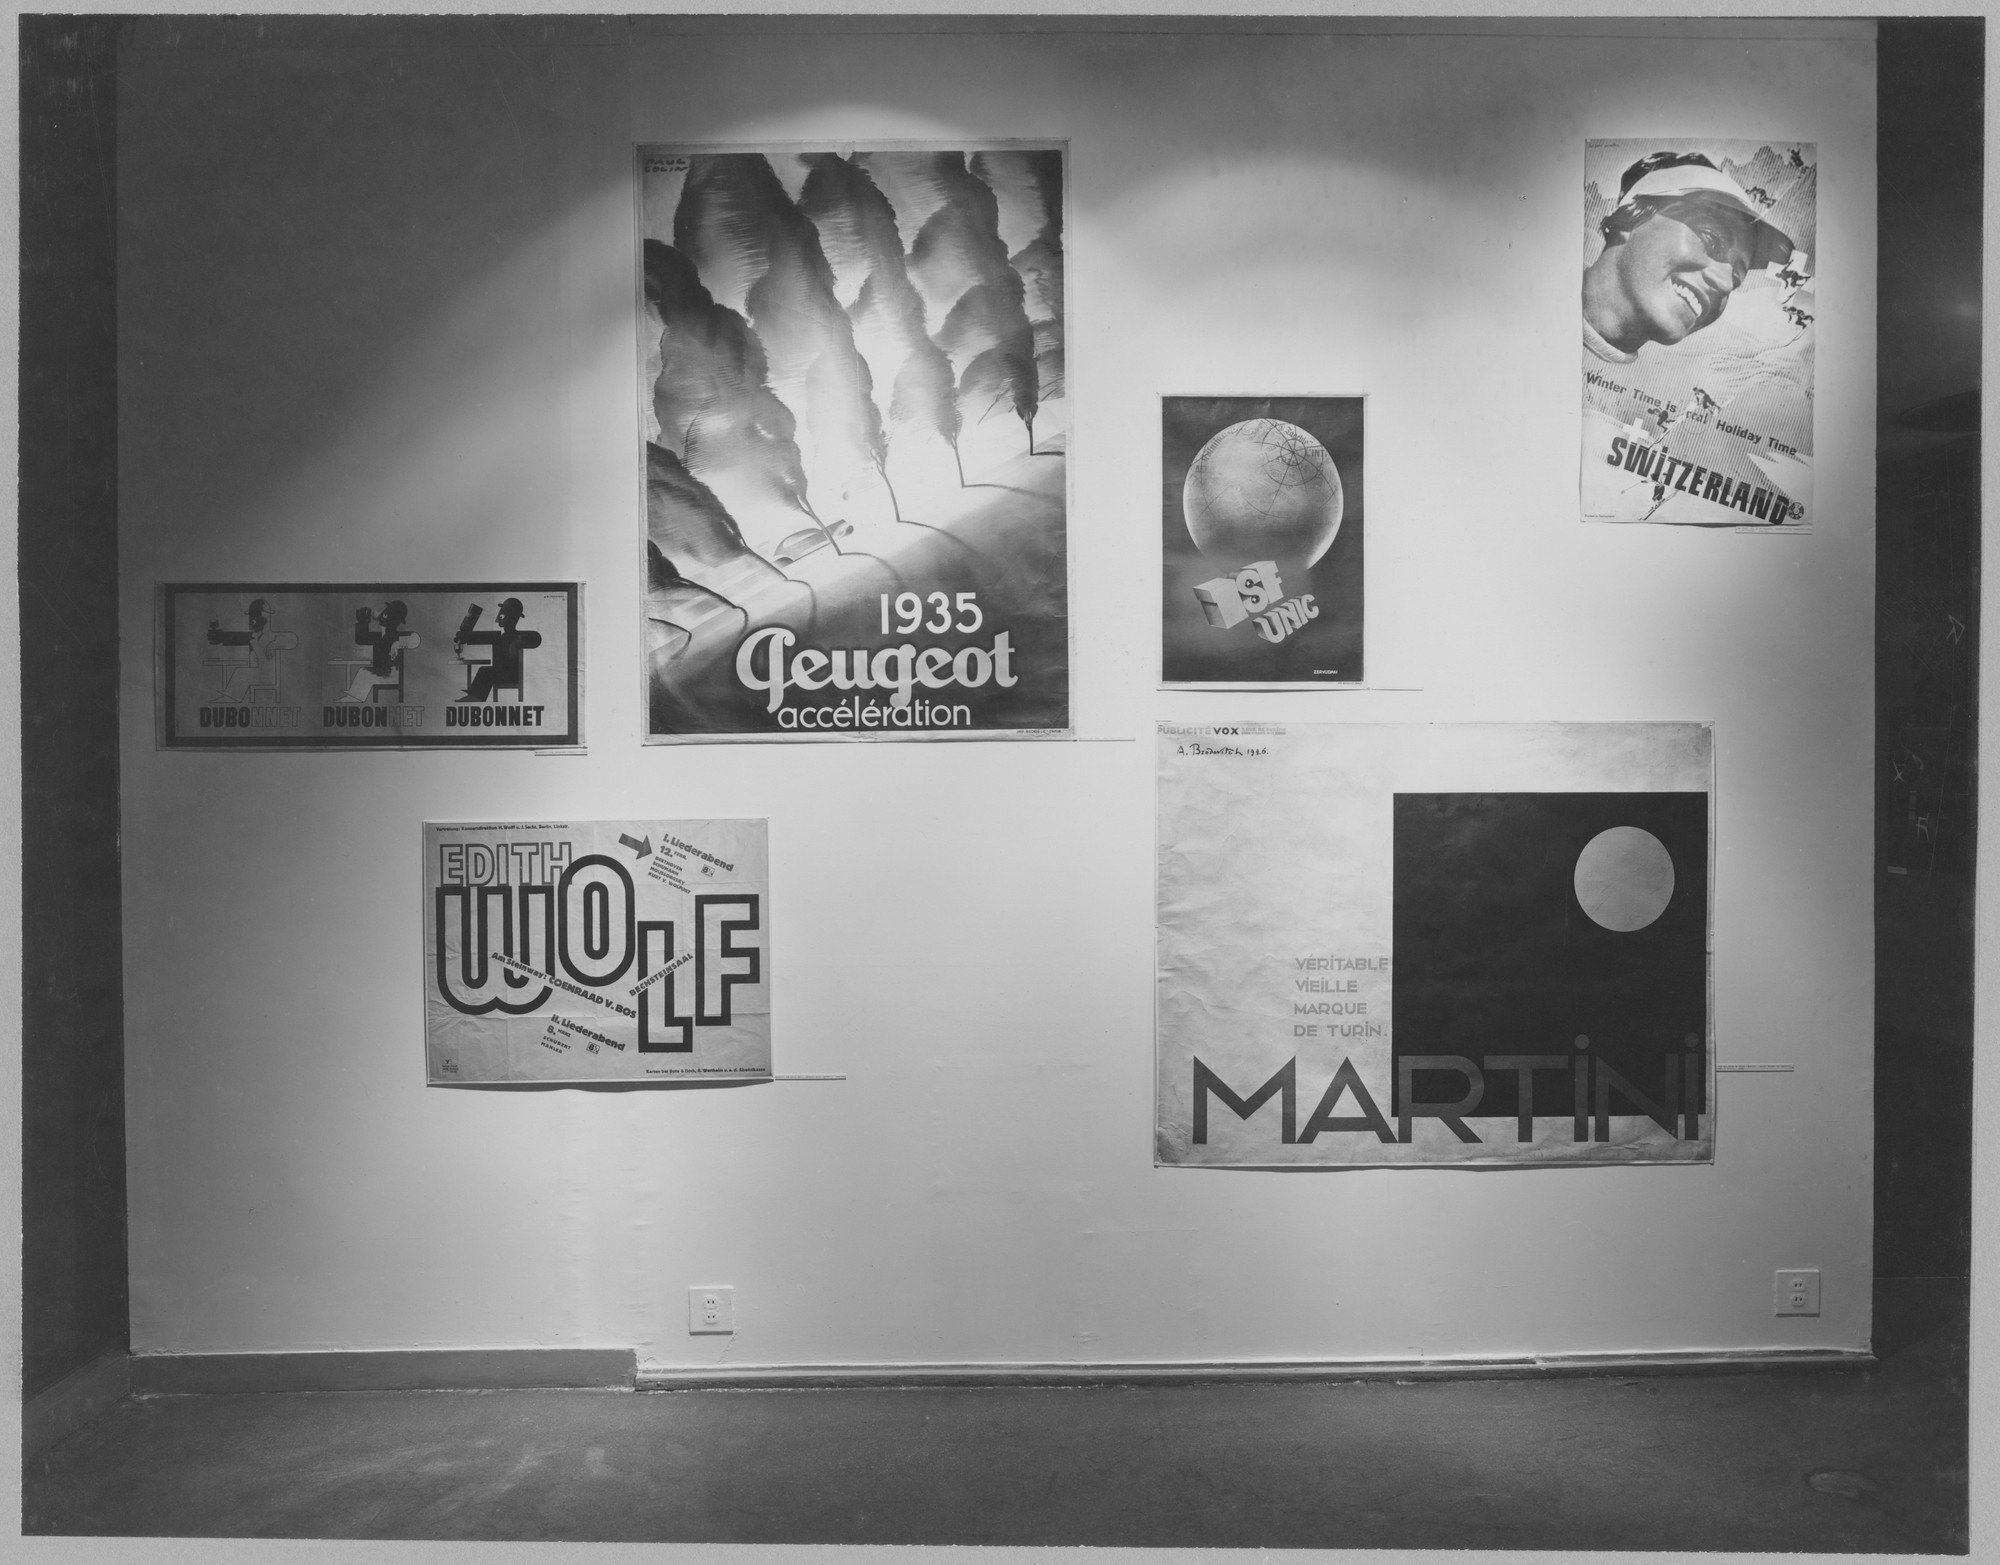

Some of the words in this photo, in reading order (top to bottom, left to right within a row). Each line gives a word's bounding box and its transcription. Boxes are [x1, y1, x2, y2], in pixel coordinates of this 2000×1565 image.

[1586, 371, 1627, 394] Winter
[1633, 388, 1662, 408] Time
[1666, 401, 1677, 413] is
[1686, 409, 1708, 425] real
[1716, 420, 1762, 445] Holiday
[1768, 436, 1798, 456] Time
[880, 591, 983, 635] 1935
[1252, 593, 1320, 644] UNIC
[735, 626, 1019, 714] Peugeot
[200, 706, 300, 728] DUBONNET
[323, 705, 425, 728] DUBONNET
[446, 705, 545, 727] DUBONNET
[777, 695, 972, 729] accélération
[1213, 727, 1239, 735] VOX
[1177, 745, 1189, 756] A.
[660, 845, 673, 858] 12.
[670, 836, 735, 872] Liederabend
[439, 841, 573, 887] EDITH
[652, 861, 679, 876] SCHUMANN
[654, 856, 683, 872] BEETHOVEN
[436, 854, 760, 1053] WOLF
[491, 952, 506, 966] Am
[506, 958, 549, 980] Steinway:
[549, 976, 604, 1005] COENRAAD
[629, 953, 694, 997] BECHSTEINSAAL
[1294, 1002, 1367, 1016] MARQUE
[547, 1025, 556, 1035] 8.
[561, 1018, 626, 1052] Liederabend
[1293, 1025, 1318, 1037] DE
[540, 1041, 563, 1054] MAHLER
[543, 1035, 572, 1050] SCHUBERT
